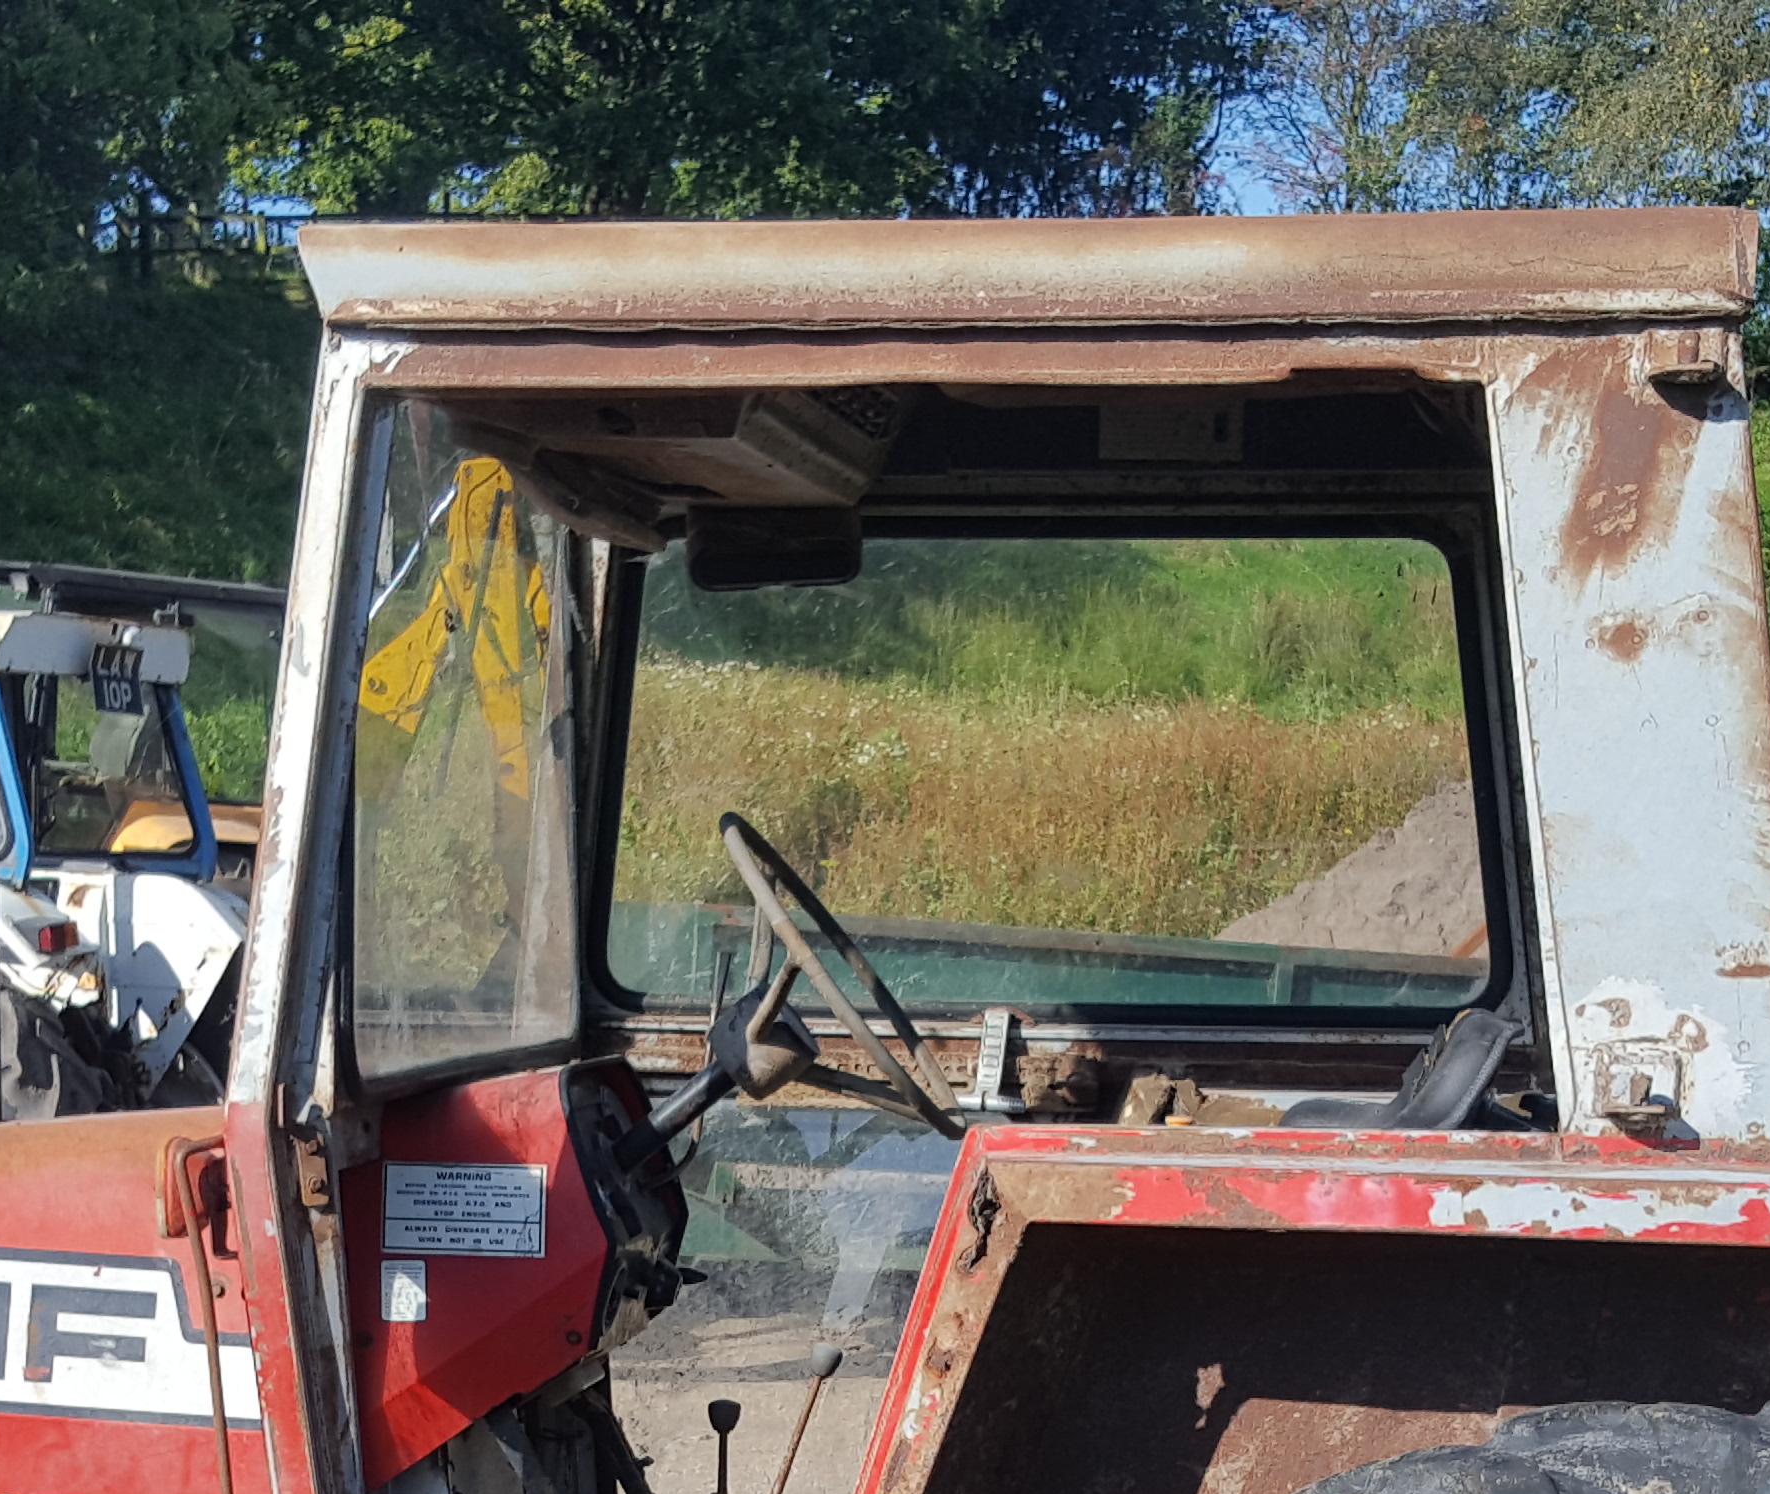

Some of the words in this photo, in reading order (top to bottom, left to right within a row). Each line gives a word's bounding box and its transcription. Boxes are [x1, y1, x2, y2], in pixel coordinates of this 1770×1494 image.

[102, 678, 132, 711] 10P
[436, 1171, 492, 1182] WARNING
[494, 1201, 512, 1209] AND
[404, 1225, 438, 1233] ALWAYS
[418, 1236, 443, 1244] WHEN
[449, 1237, 466, 1245] NOT
